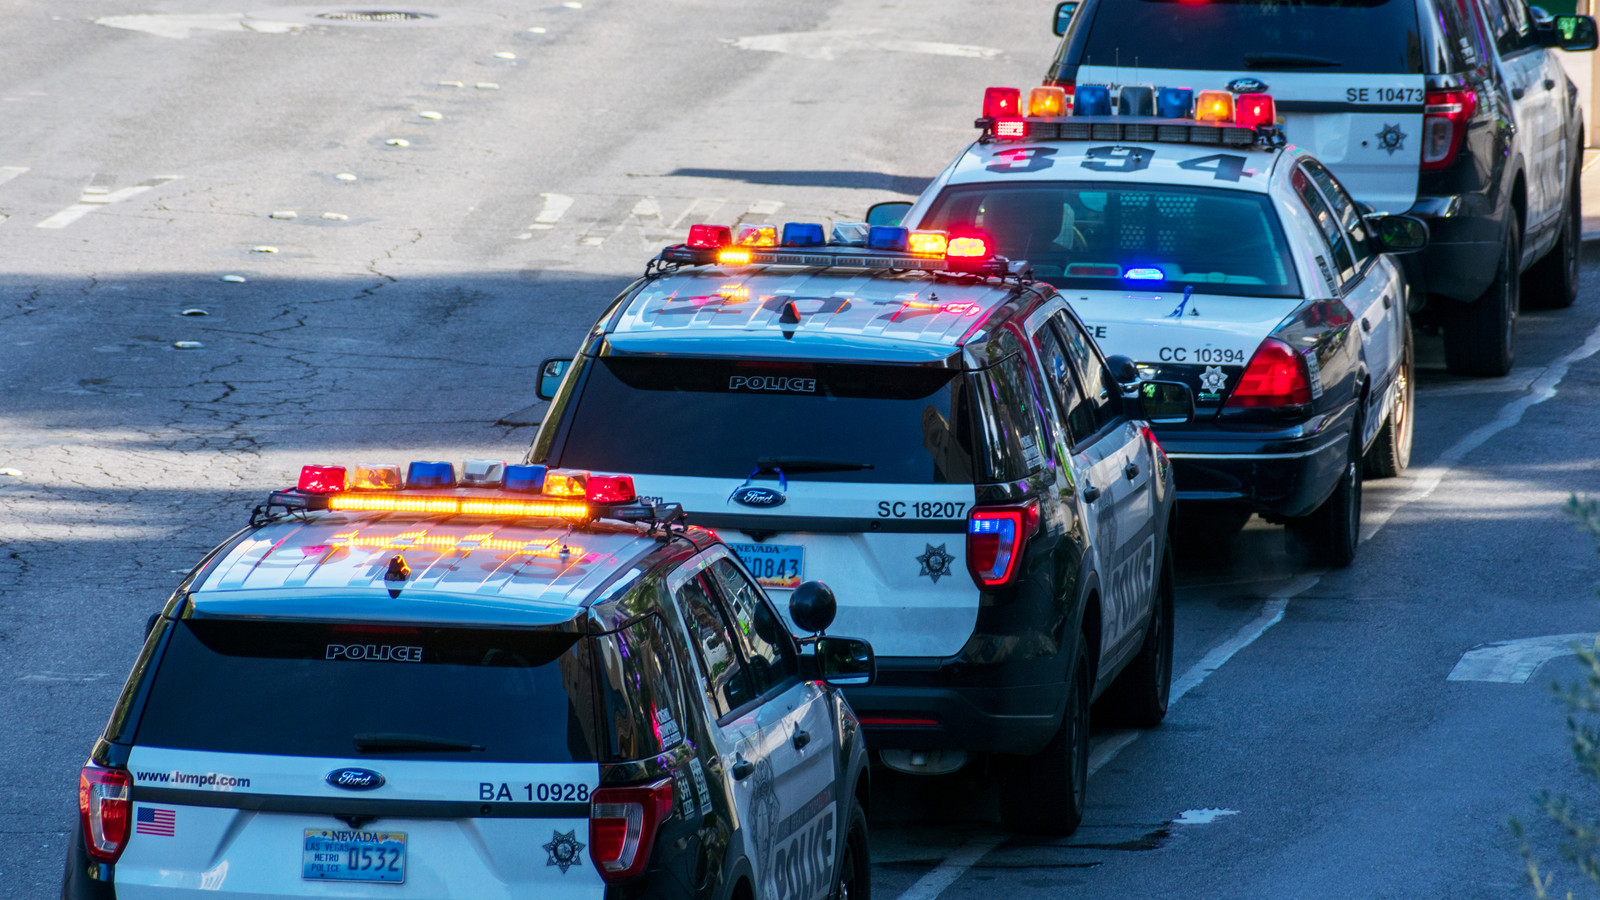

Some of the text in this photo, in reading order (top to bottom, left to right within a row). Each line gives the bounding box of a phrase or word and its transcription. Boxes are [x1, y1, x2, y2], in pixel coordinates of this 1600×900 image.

[1346, 87, 1424, 102] SE 10473
[985, 145, 1253, 183] 394
[1159, 346, 1245, 363] CC 10394
[728, 375, 817, 393] POLICE
[743, 490, 774, 504] Ford
[877, 500, 966, 518] SC 18207
[735, 544, 781, 554] NEVADA
[752, 557, 799, 580] 0843
[325, 643, 423, 662] POLICE
[136, 770, 251, 788] www.lvmpd.com
[338, 770, 372, 786] Ford
[479, 782, 590, 802] BA 10928
[331, 830, 380, 843] NEVADA
[305, 842, 350, 853] LAS VEGAS
[314, 853, 340, 862] METRO
[347, 846, 399, 873] 0532
[311, 863, 341, 873] POLICE
